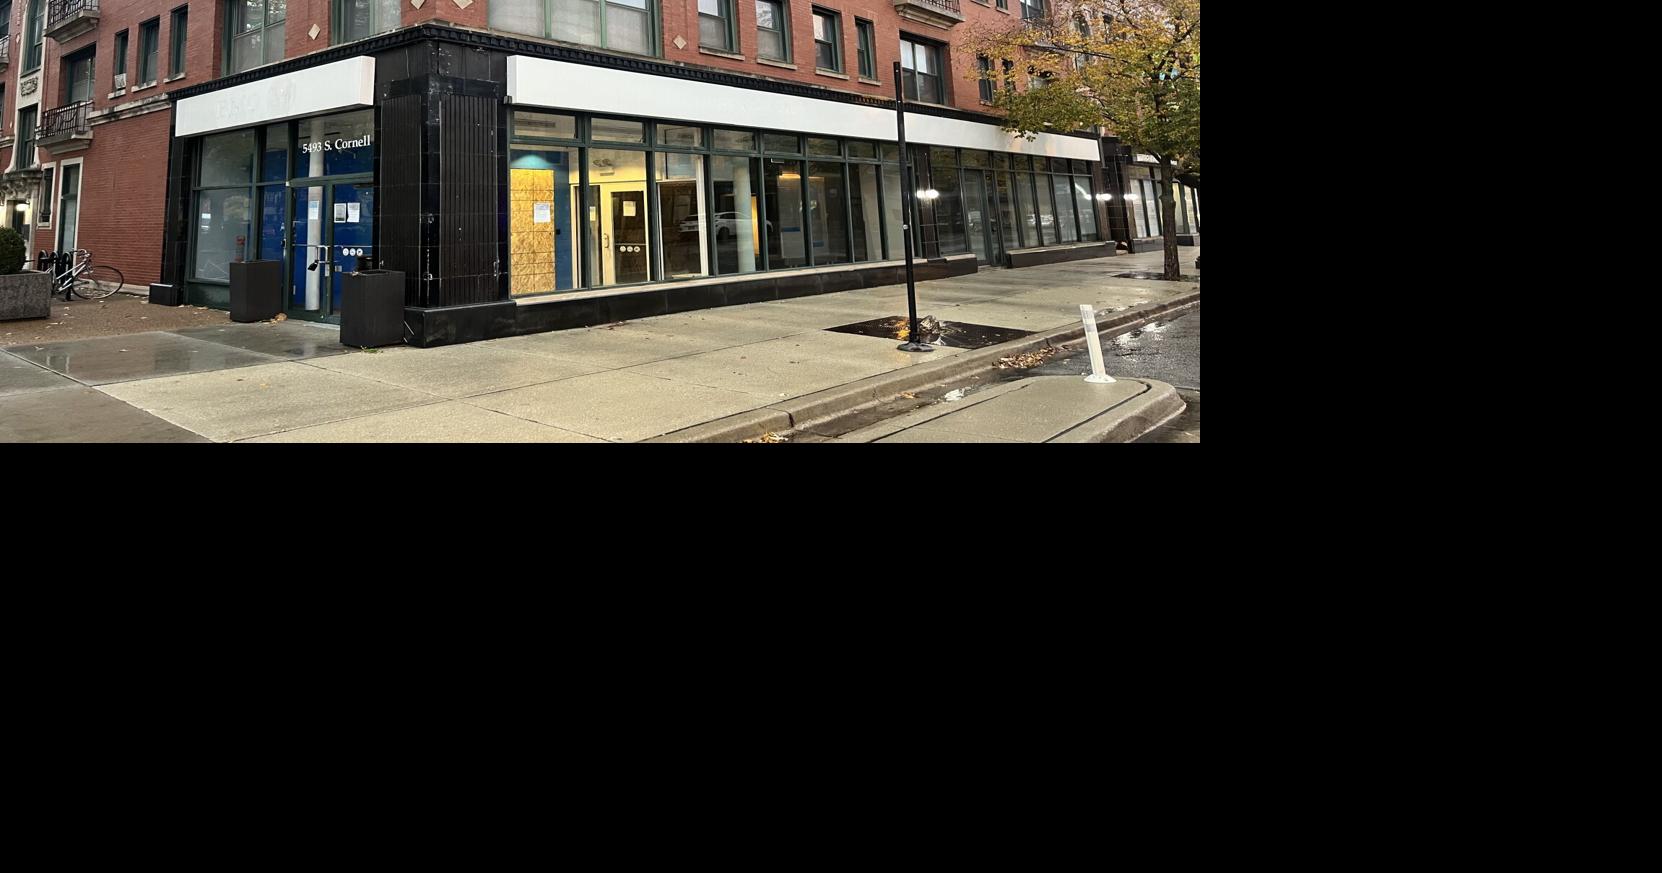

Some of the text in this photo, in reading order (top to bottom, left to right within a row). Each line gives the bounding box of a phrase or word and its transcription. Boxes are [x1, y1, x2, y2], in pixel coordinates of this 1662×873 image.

[302, 134, 371, 154] 5493 S. Cornell
